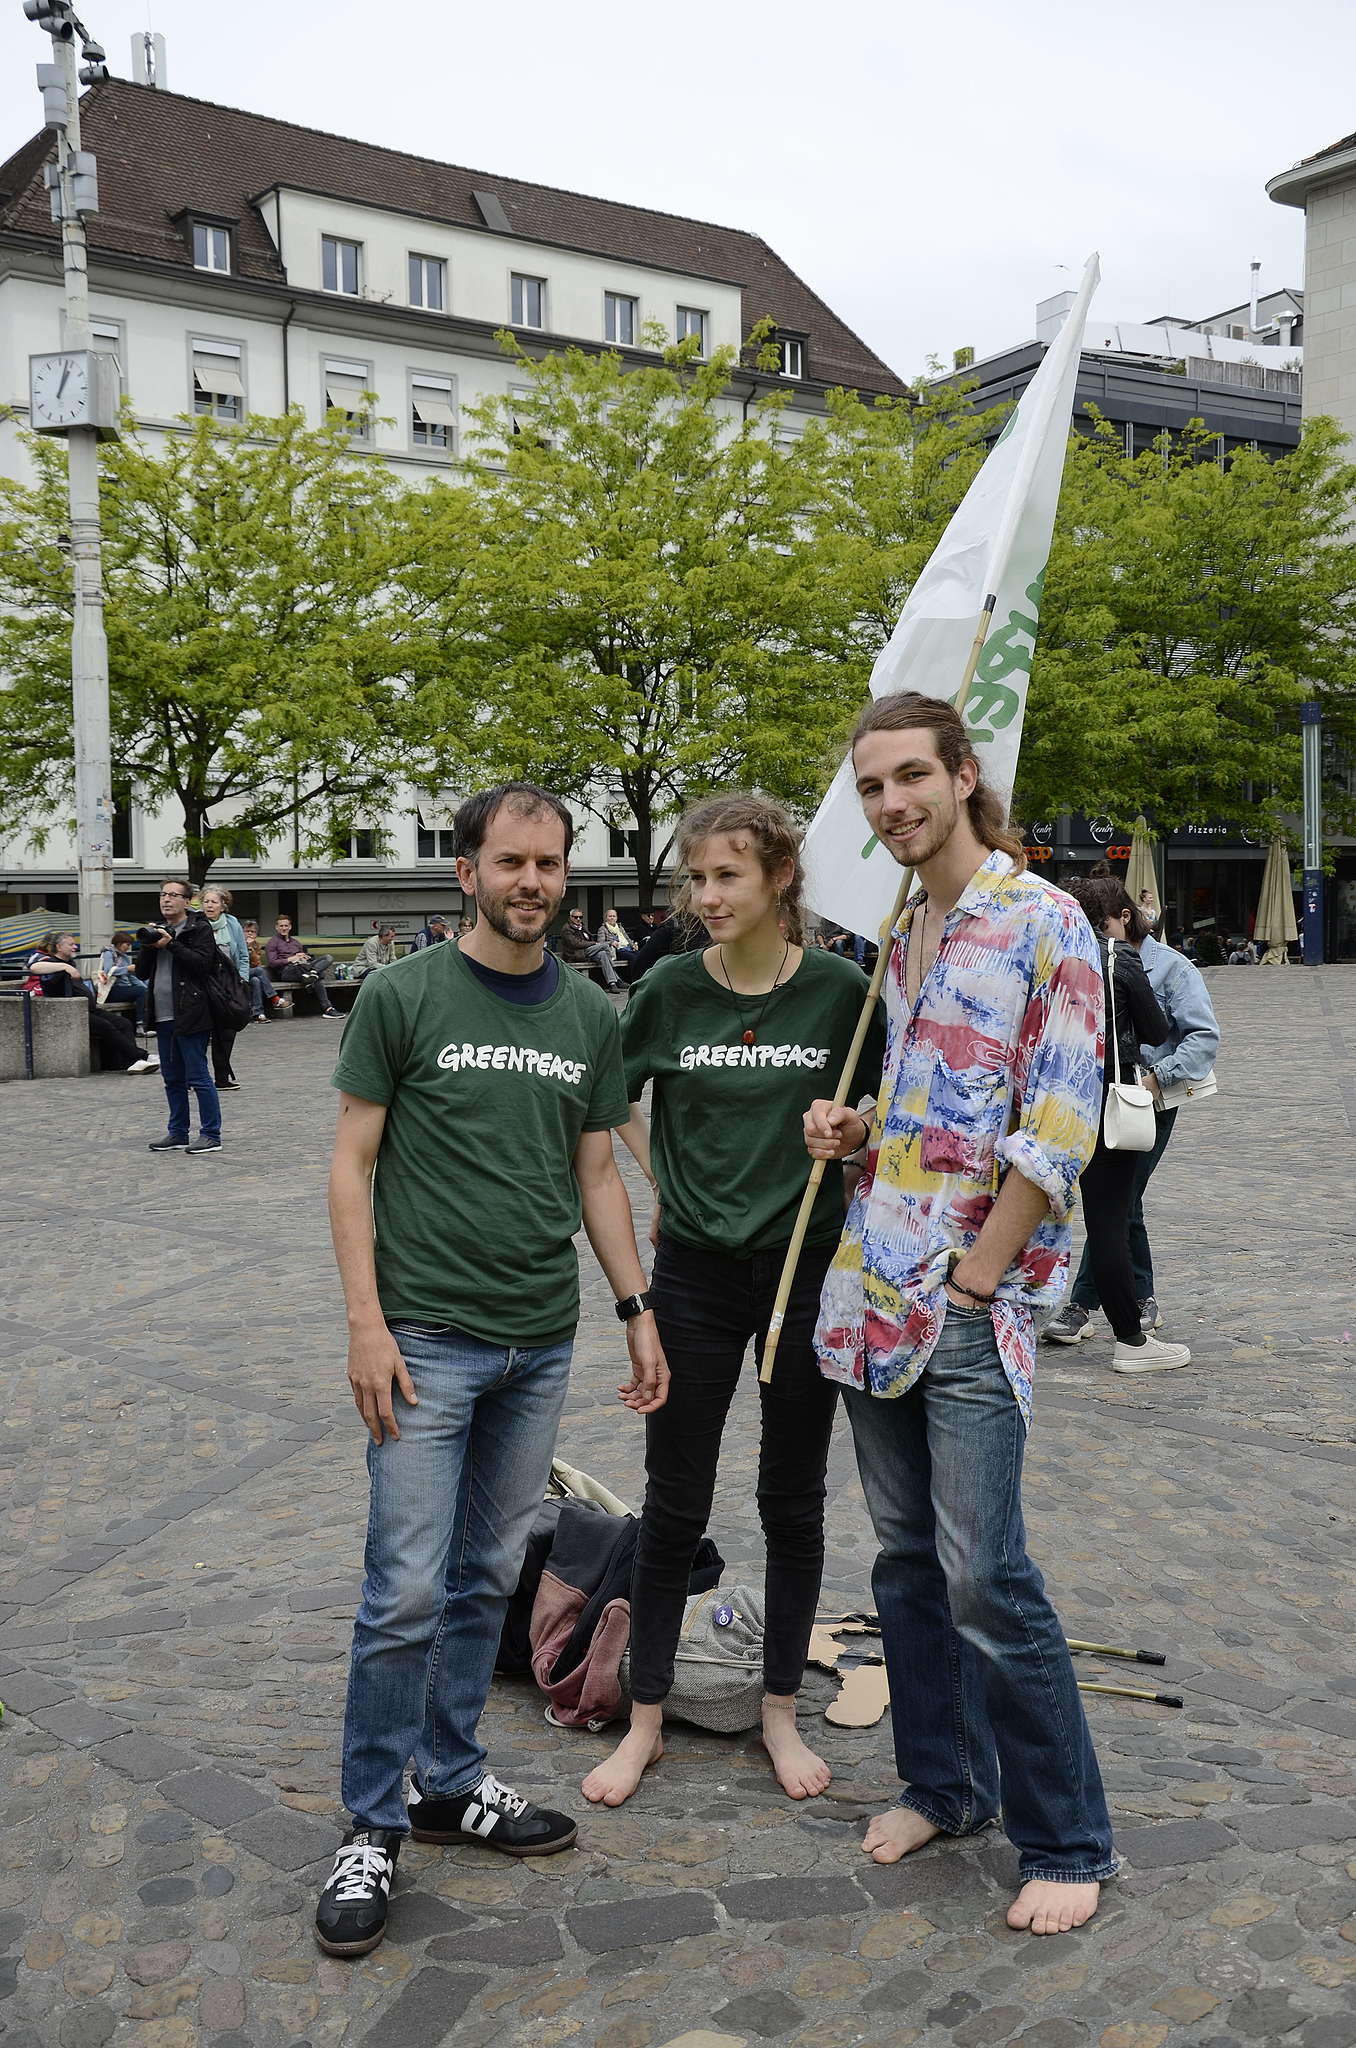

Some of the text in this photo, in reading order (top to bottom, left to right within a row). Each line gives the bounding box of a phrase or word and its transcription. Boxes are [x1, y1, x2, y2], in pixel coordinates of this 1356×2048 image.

[1188, 824, 1227, 834] Pizzeria
[1024, 846, 1054, 863] oop
[437, 1043, 586, 1085] GREENPEACE
[679, 1044, 831, 1070] GREENPEACE
